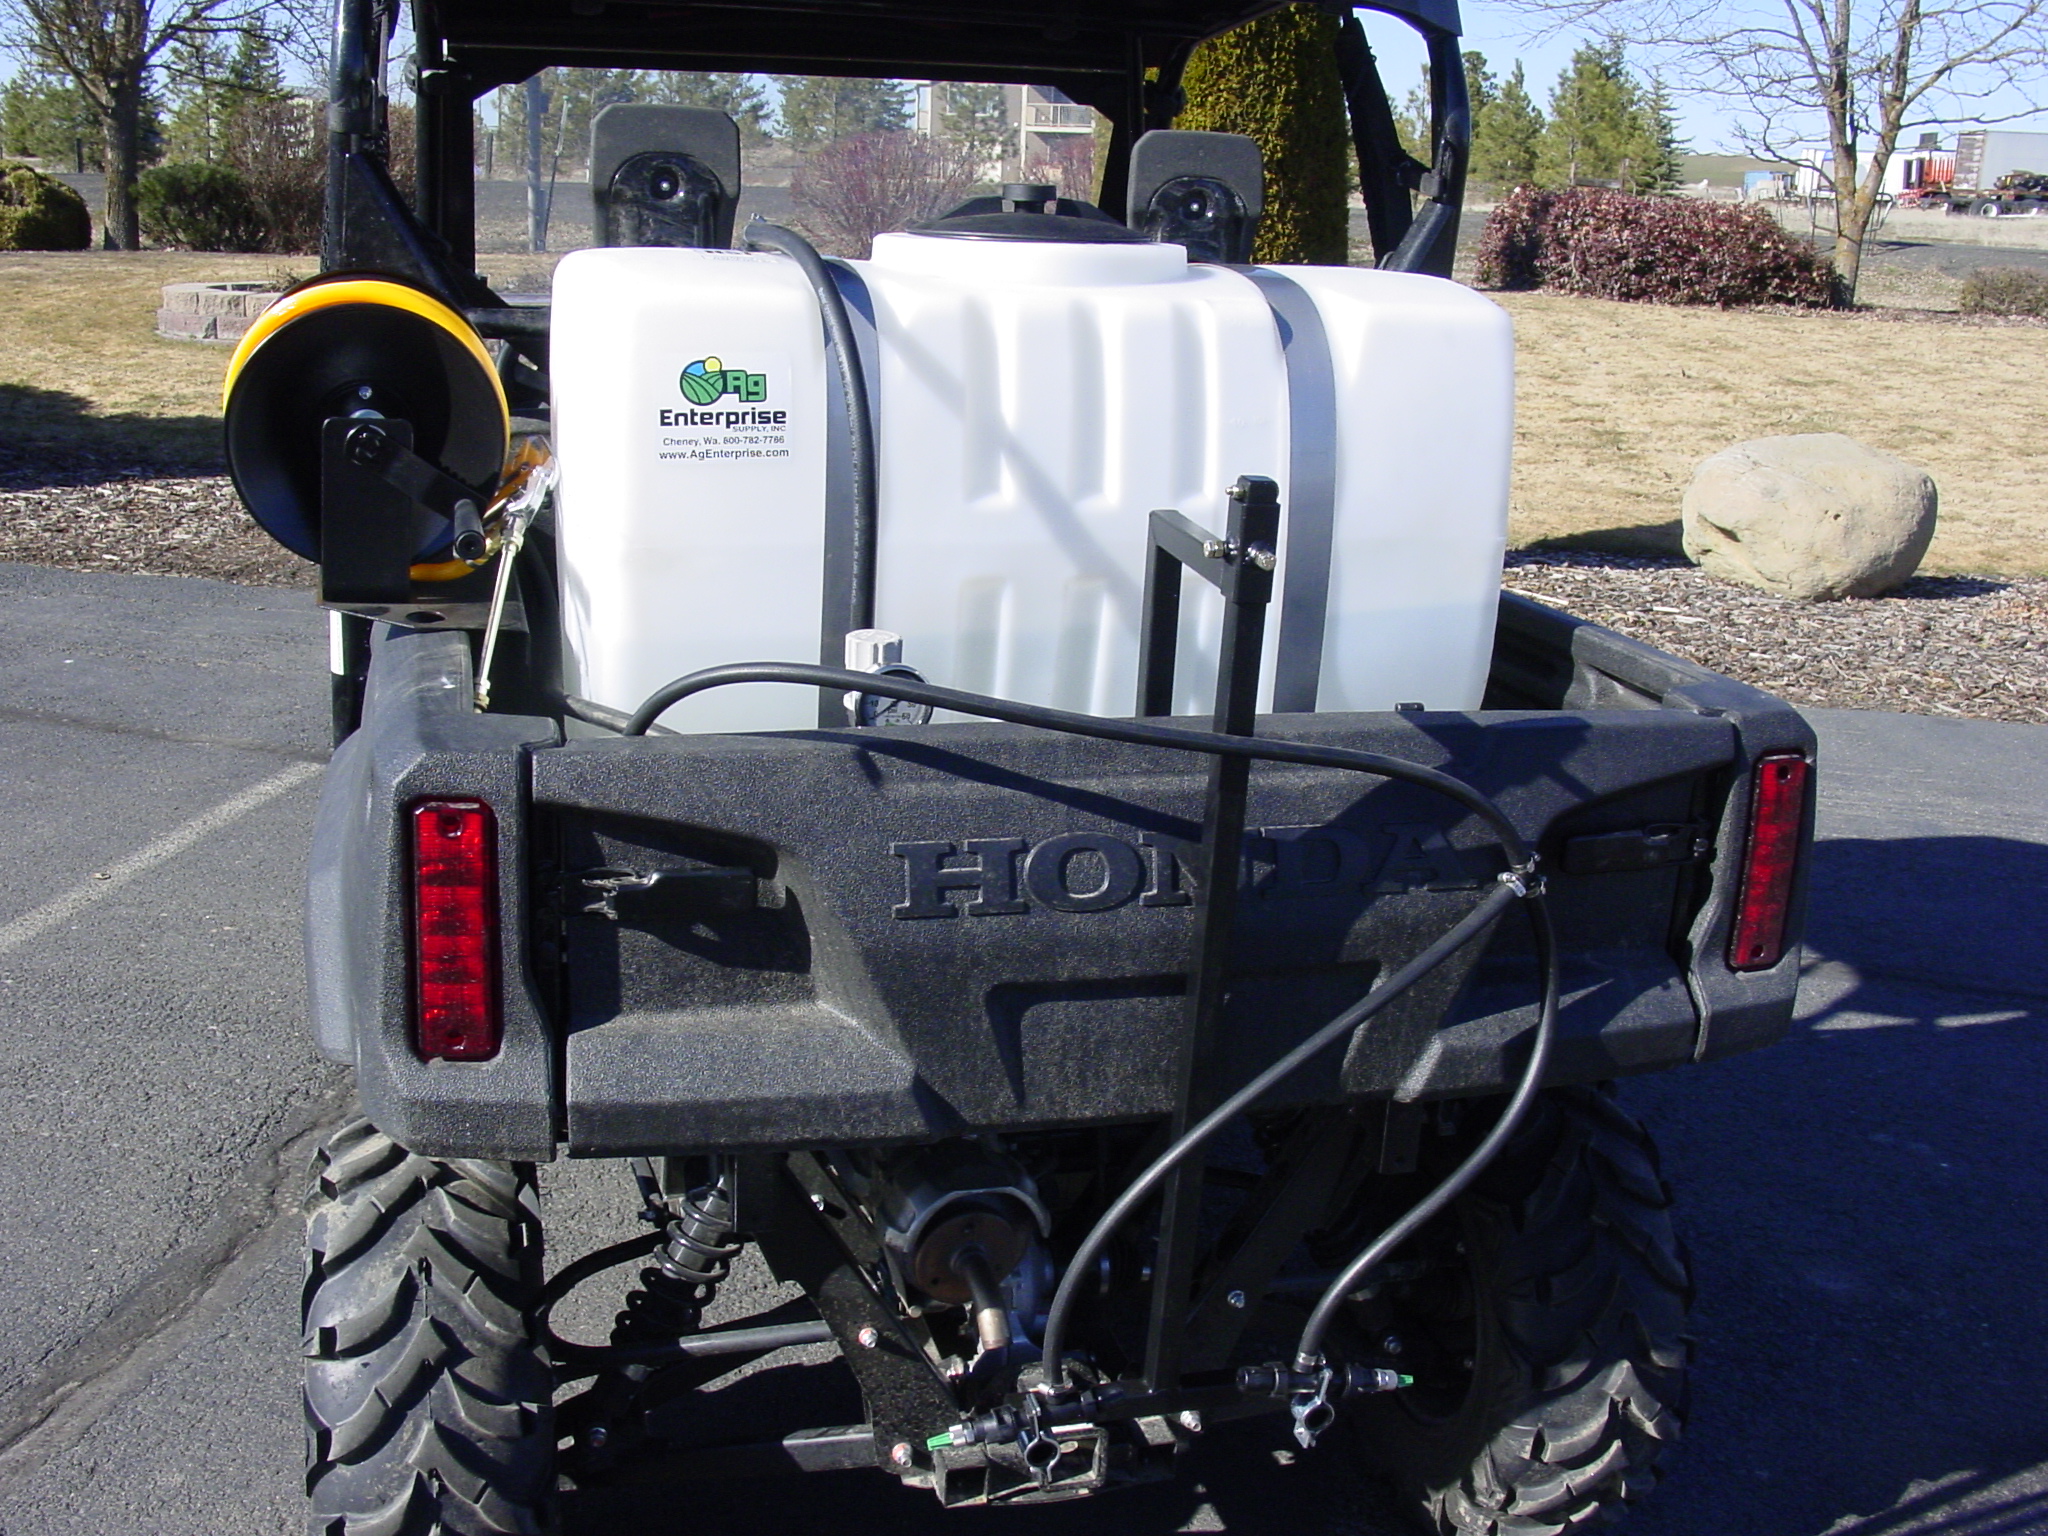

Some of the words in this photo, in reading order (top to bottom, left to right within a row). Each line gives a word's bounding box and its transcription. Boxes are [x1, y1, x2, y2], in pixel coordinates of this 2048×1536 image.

[725, 370, 767, 402] Ag
[659, 407, 787, 429] Enterprise
[732, 425, 769, 433] SUPPLY,
[663, 437, 702, 447] Cheney,
[703, 436, 721, 445] Wa.
[658, 448, 789, 461] www.AgEnterprise.com
